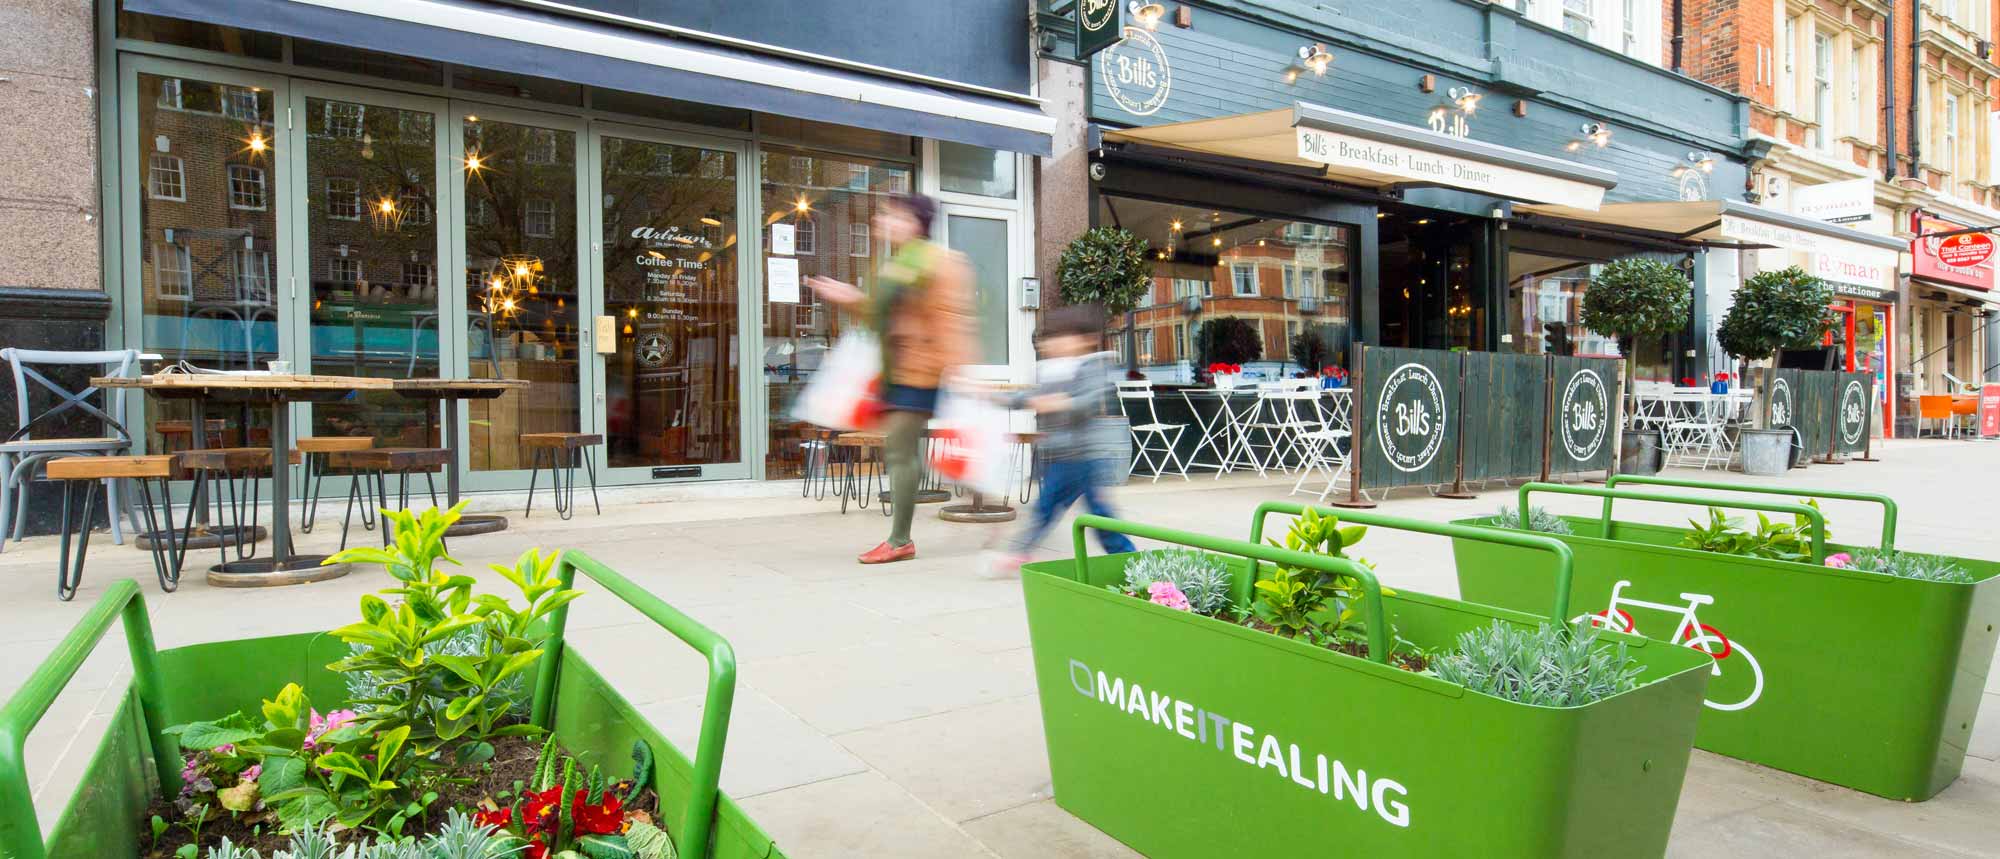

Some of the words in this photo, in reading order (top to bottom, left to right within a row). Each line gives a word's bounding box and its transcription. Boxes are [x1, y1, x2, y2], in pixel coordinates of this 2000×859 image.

[1116, 54, 1157, 88] Bill's
[1303, 133, 1327, 156] Bill's
[1339, 141, 1400, 168] Breakfast
[1408, 155, 1444, 175] Lunch
[1453, 163, 1491, 184] Dinner
[636, 255, 673, 267] Coffee
[1819, 254, 1880, 280] Rman
[647, 272, 671, 280] Monday
[660, 290, 686, 298] Saturday
[1838, 284, 1881, 298] stationer
[662, 308, 684, 316] Sunday
[1382, 373, 1406, 412] Breakfast
[1408, 369, 1428, 385] Lunch
[1428, 380, 1440, 413] Dinner
[1395, 400, 1430, 436] Bill's
[1572, 401, 1597, 431] Bill's
[1383, 422, 1396, 456] Dinner
[1417, 422, 1442, 462] Breakfast
[1396, 451, 1416, 466] Lunch
